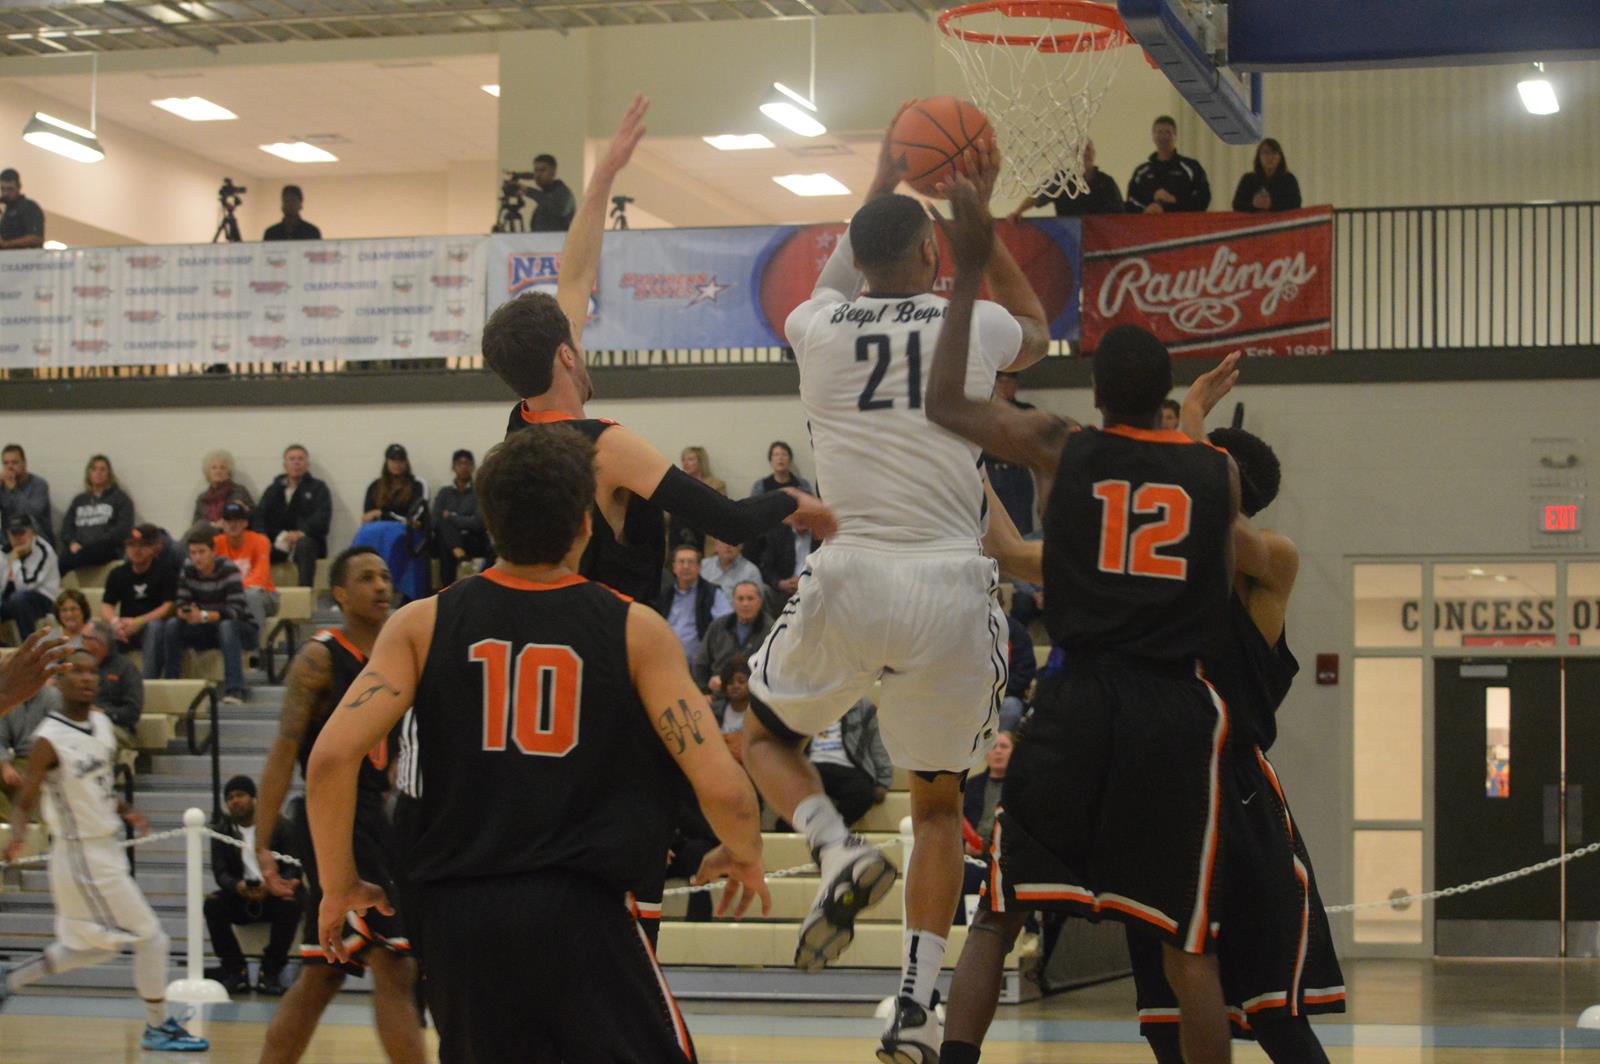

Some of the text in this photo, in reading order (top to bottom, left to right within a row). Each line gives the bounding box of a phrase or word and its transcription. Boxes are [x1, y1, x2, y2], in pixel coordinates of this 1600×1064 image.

[830, 303, 889, 328] Beep!
[1098, 245, 1317, 317] Rawlings
[855, 331, 922, 411] 21
[1092, 478, 1192, 581] 12
[1544, 505, 1577, 530] EXIT
[1401, 600, 1600, 631] CNCESSO
[468, 638, 583, 758] 10
